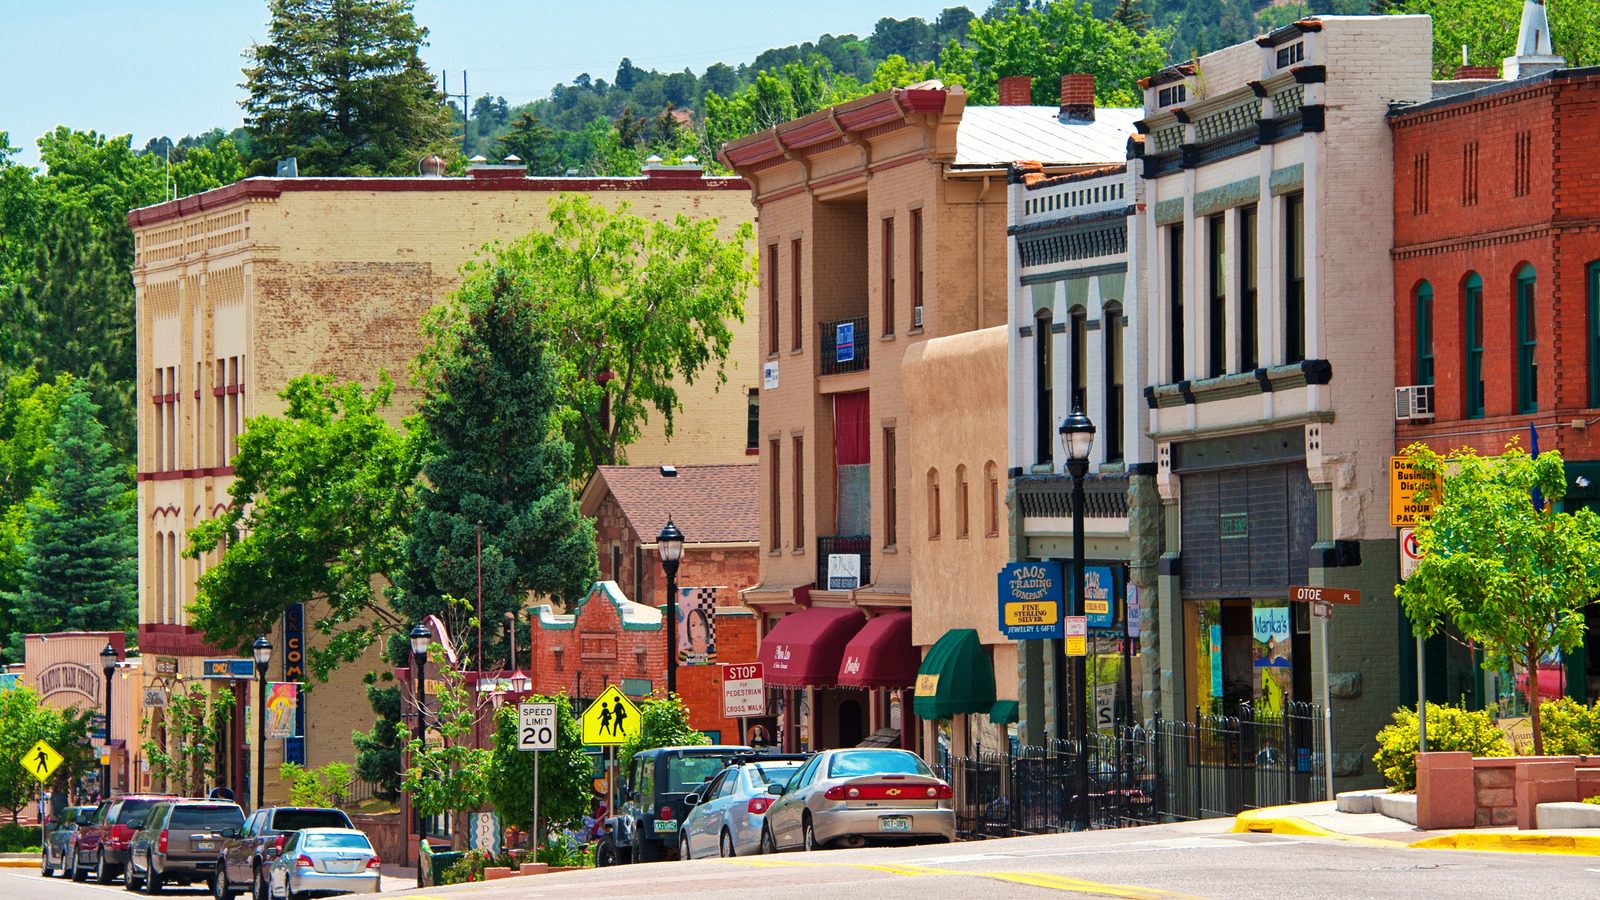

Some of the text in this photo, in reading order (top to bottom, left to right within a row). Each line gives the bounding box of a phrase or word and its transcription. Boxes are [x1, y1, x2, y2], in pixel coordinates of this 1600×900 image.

[1013, 566, 1046, 580] TAOS
[1009, 579, 1052, 589] TRADING
[1012, 588, 1048, 600] COMPANY
[1297, 588, 1322, 600] OTOE
[1254, 608, 1287, 633] Marika's
[1008, 626, 1034, 634] JEWELRY
[729, 666, 757, 679] STOP
[726, 688, 762, 697] PEDESTRIAN
[523, 708, 553, 716] SPEED
[526, 718, 548, 726] LIMIT
[522, 726, 552, 745] 20
